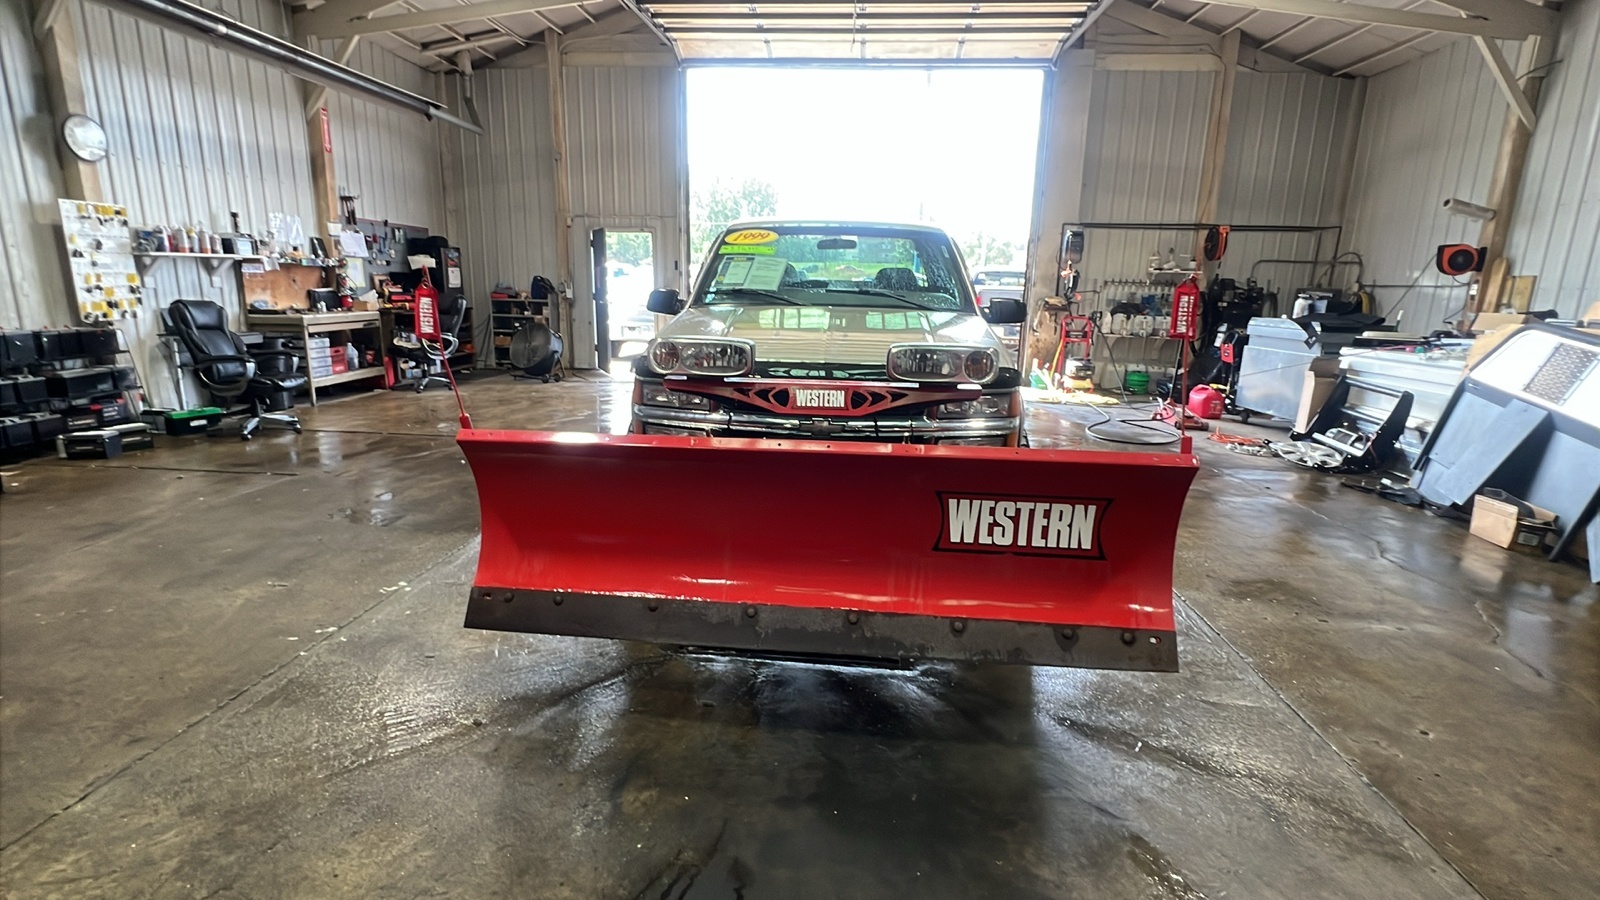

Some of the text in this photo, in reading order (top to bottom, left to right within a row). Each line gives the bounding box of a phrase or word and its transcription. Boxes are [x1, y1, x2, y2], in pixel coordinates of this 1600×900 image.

[733, 232, 771, 242] 1999
[419, 297, 434, 333] WESTERN
[796, 389, 845, 407] WESTERN
[948, 498, 1097, 550] WESTERN
